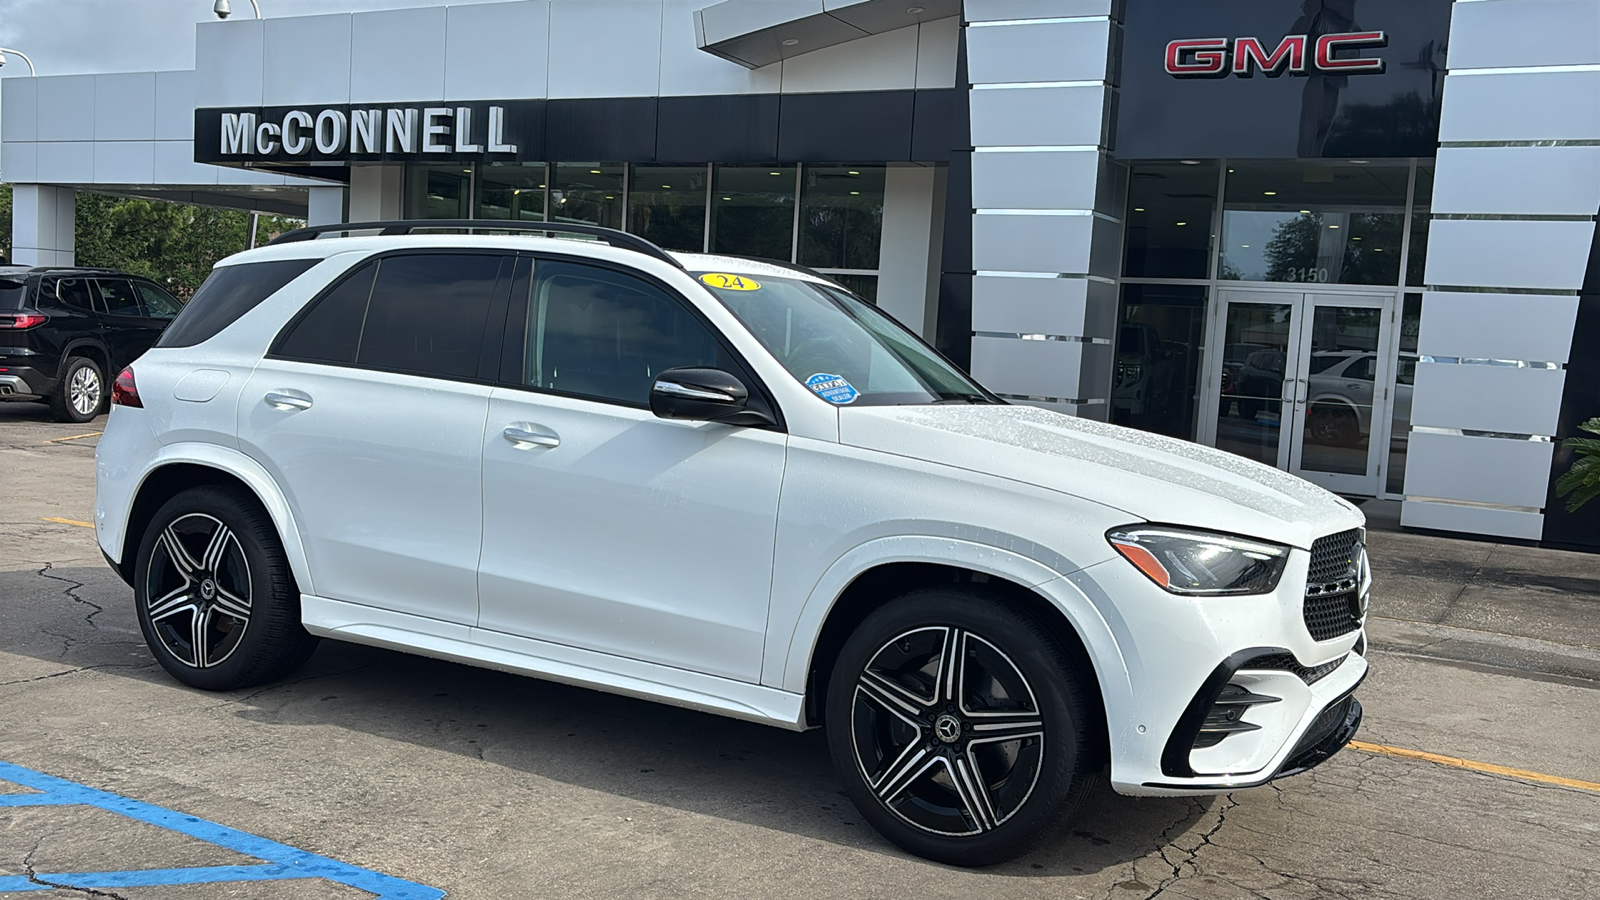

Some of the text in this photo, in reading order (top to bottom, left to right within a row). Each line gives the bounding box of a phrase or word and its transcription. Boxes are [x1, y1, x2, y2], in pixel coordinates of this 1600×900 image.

[1164, 30, 1386, 76] GMC
[220, 106, 518, 155] McCONNELL
[716, 274, 745, 289] 24
[1286, 266, 1329, 283] 3150
